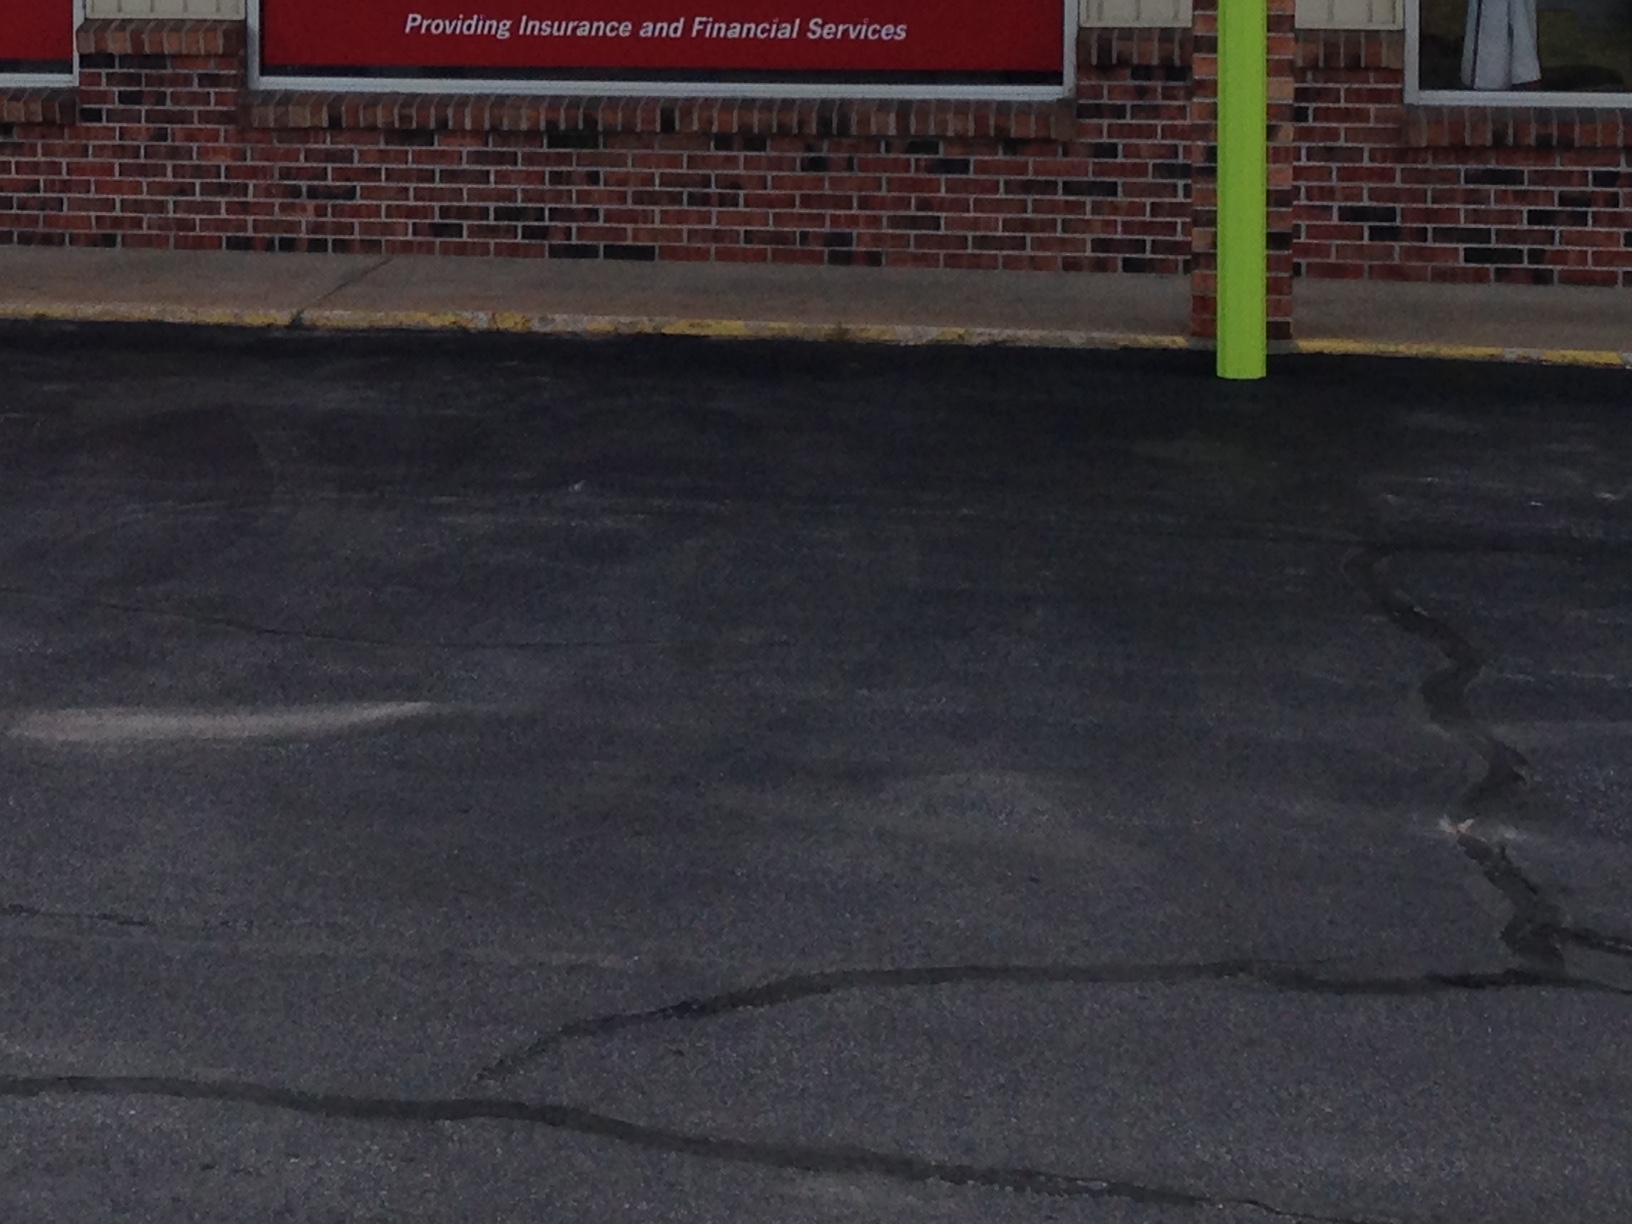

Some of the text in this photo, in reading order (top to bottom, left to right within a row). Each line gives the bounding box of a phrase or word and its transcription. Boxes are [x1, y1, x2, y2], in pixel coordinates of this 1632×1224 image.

[405, 13, 907, 40] Providing Insurance and Financial Services
